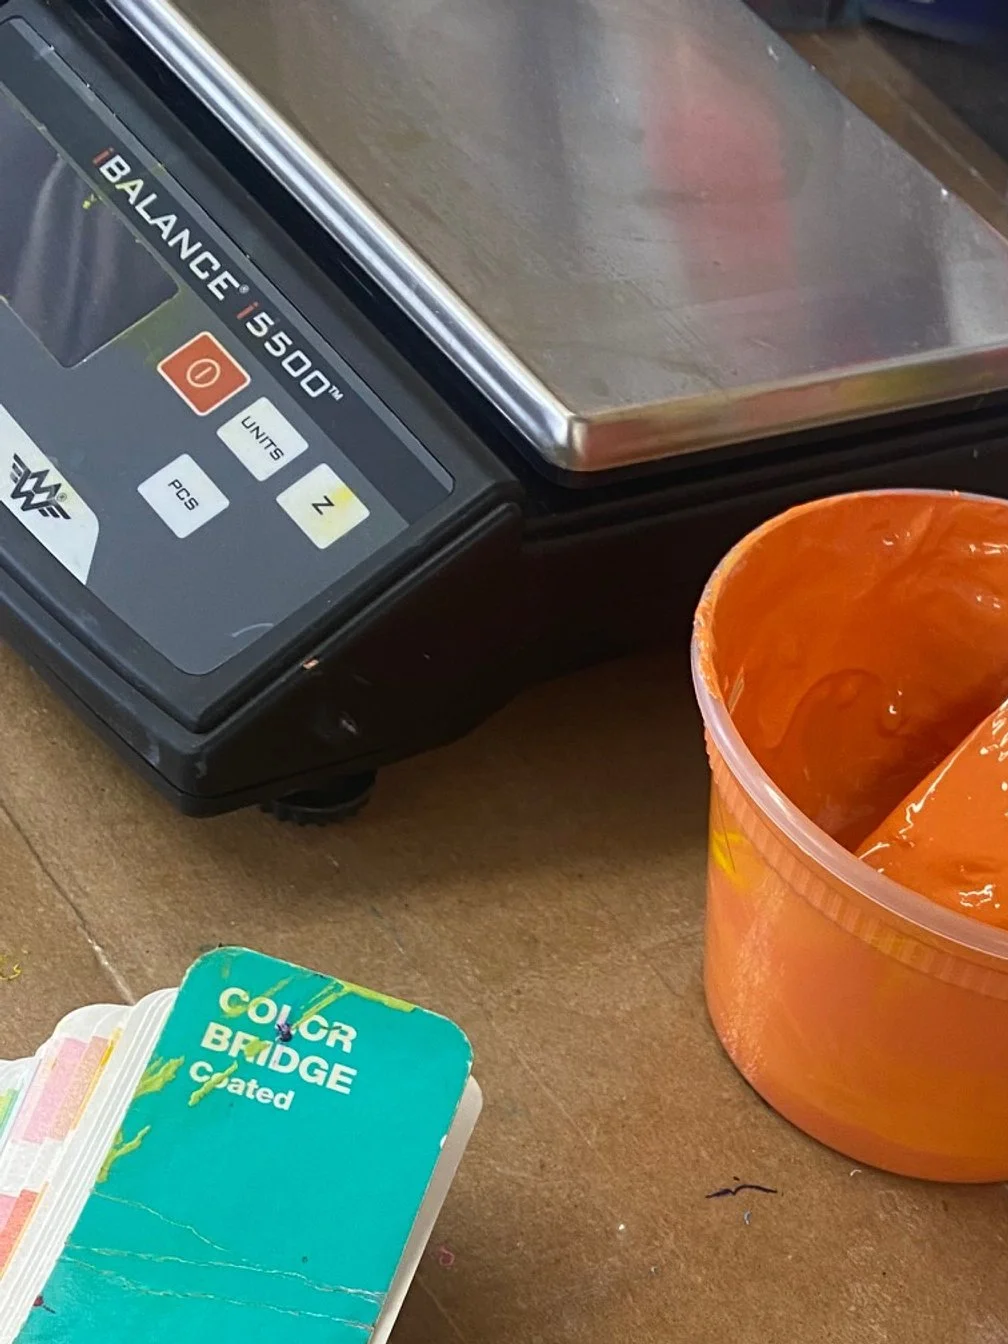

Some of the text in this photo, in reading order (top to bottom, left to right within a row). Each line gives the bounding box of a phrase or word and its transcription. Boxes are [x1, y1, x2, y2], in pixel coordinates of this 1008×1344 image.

[241, 414, 286, 462] UNITS
[166, 478, 199, 514] PCS
[311, 495, 333, 515] Z
[219, 987, 358, 1053] COLOR
[201, 1023, 358, 1095] BRIDGE
